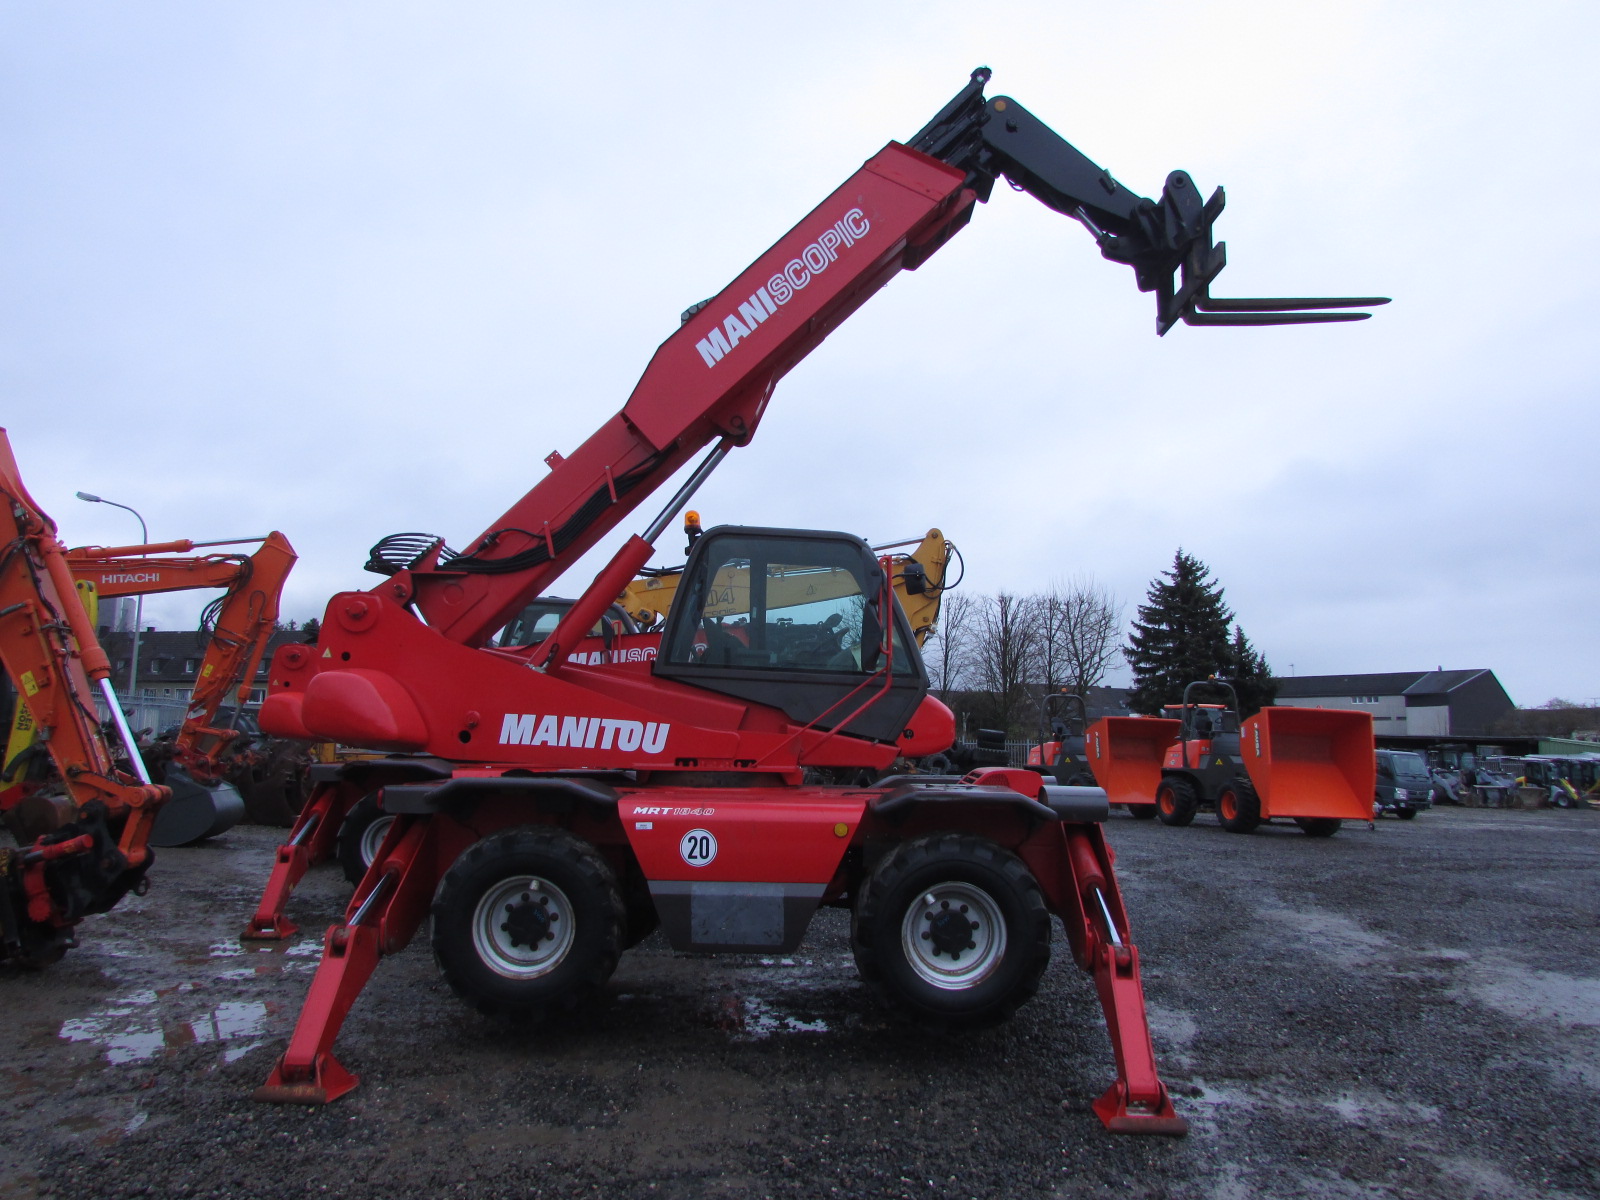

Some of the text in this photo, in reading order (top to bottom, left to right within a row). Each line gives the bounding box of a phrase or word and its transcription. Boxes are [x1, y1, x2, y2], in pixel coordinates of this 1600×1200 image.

[695, 208, 870, 369] MANISCOPIC
[102, 573, 160, 584] HITACHI
[499, 713, 671, 754] MANITOU
[633, 806, 673, 815] MRT
[688, 835, 710, 860] 20
